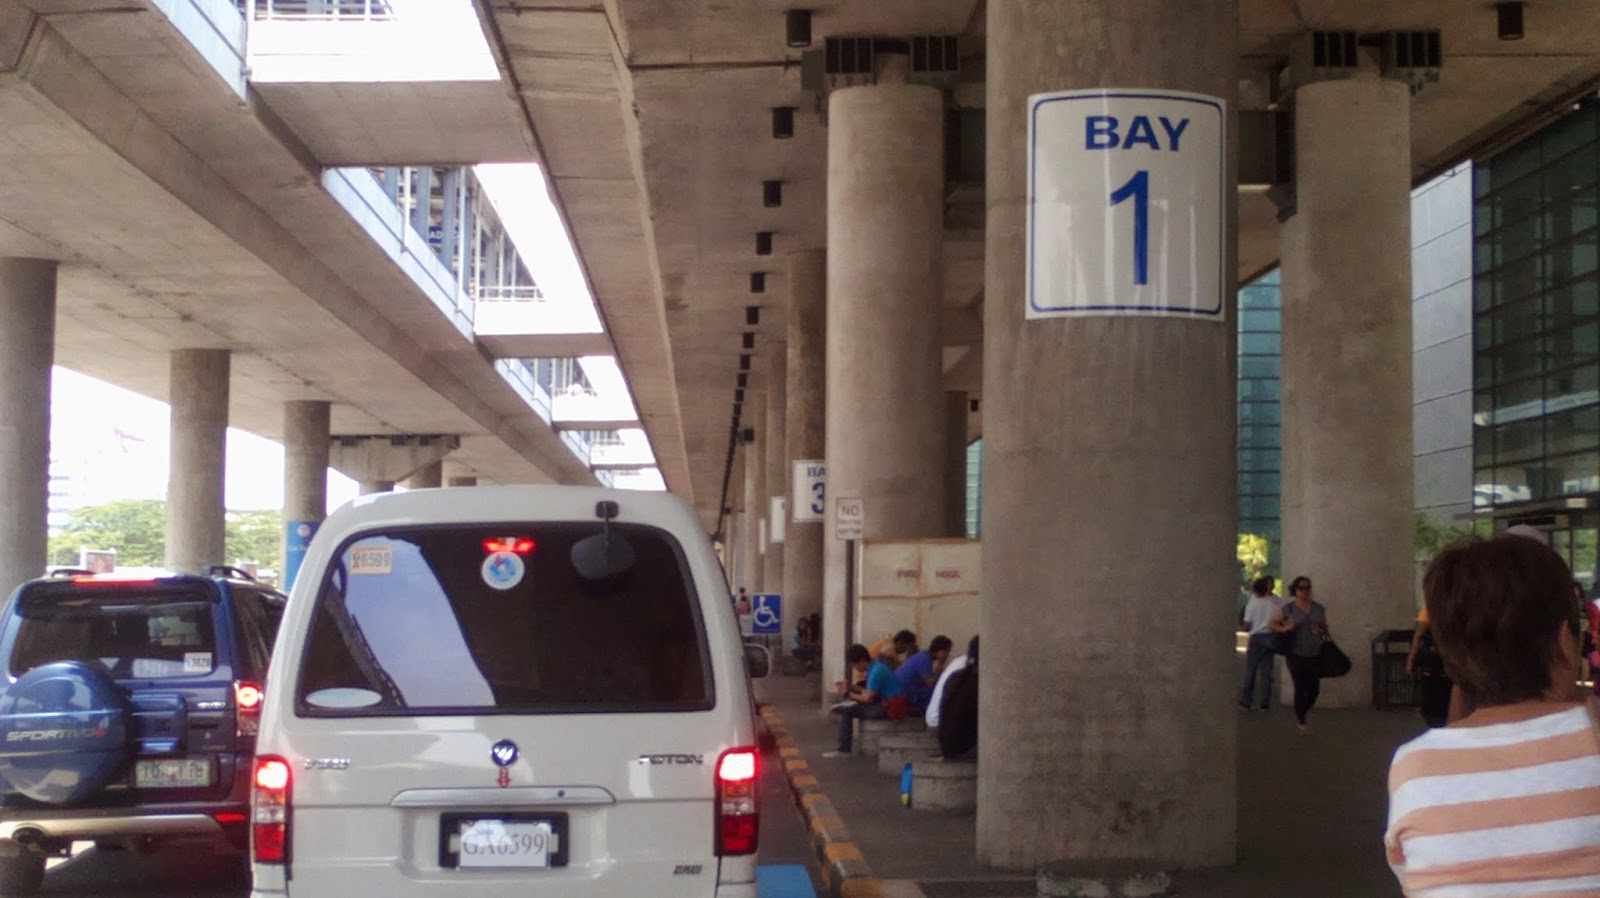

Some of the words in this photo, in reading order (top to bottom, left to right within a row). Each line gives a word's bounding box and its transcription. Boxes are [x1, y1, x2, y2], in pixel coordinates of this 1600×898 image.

[1085, 115, 1190, 152] BAY
[1110, 170, 1149, 285] 1
[807, 467, 825, 477] BA
[811, 482, 825, 514] 3
[842, 505, 860, 516] NO
